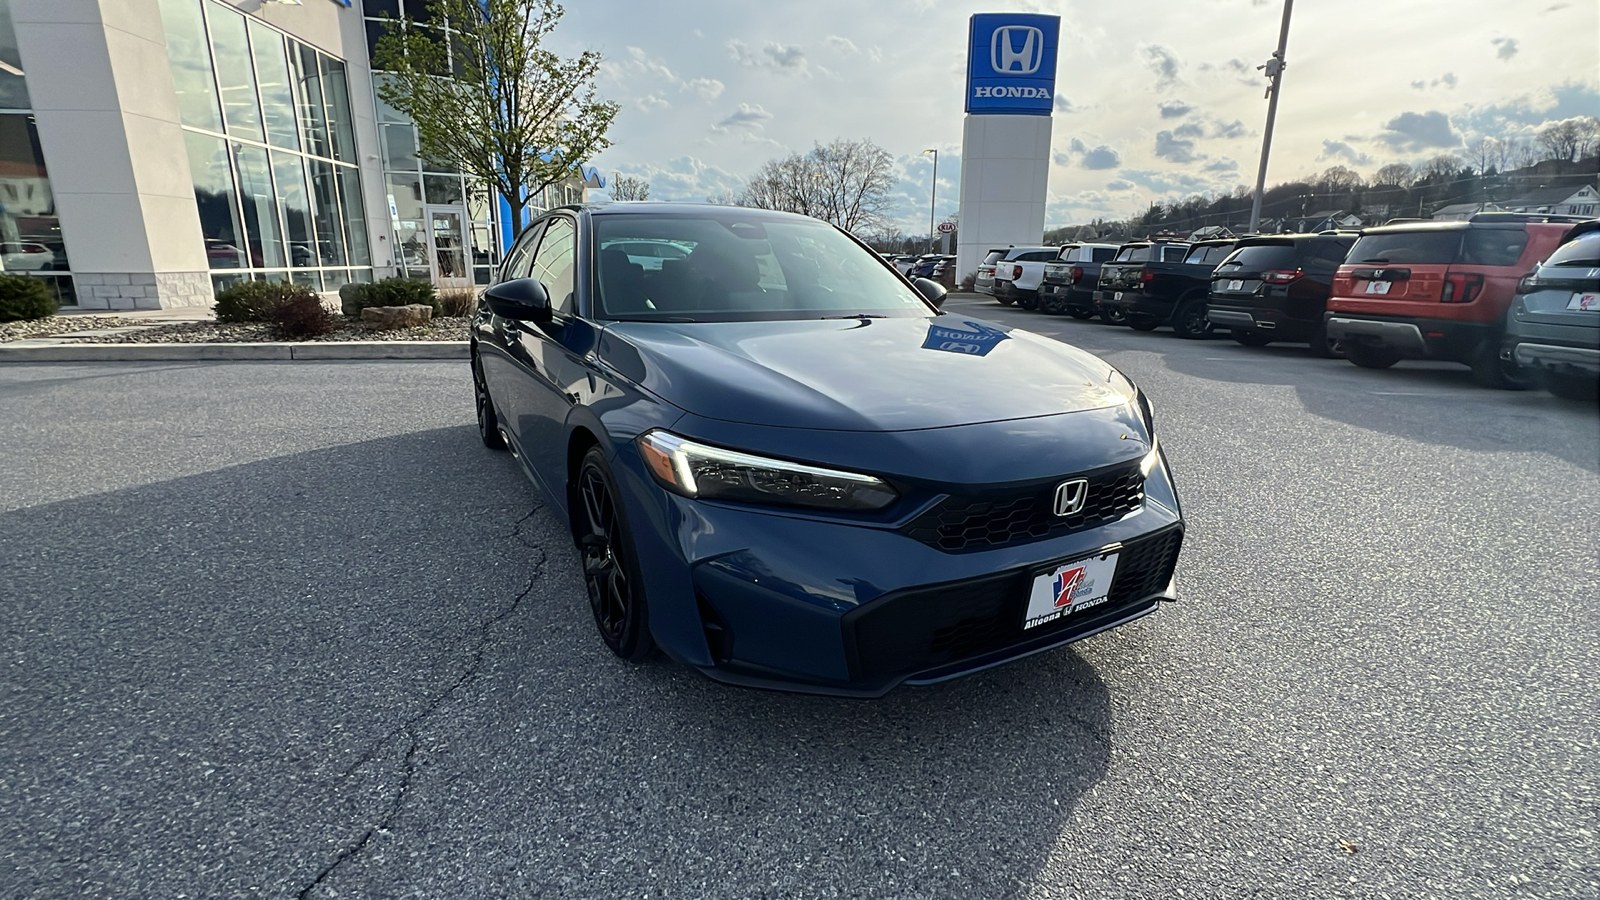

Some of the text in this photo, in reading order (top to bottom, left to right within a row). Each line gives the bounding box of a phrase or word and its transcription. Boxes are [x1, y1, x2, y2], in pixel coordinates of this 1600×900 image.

[974, 86, 1051, 99] HONDA
[1024, 597, 1108, 630] Altoona HONDA
